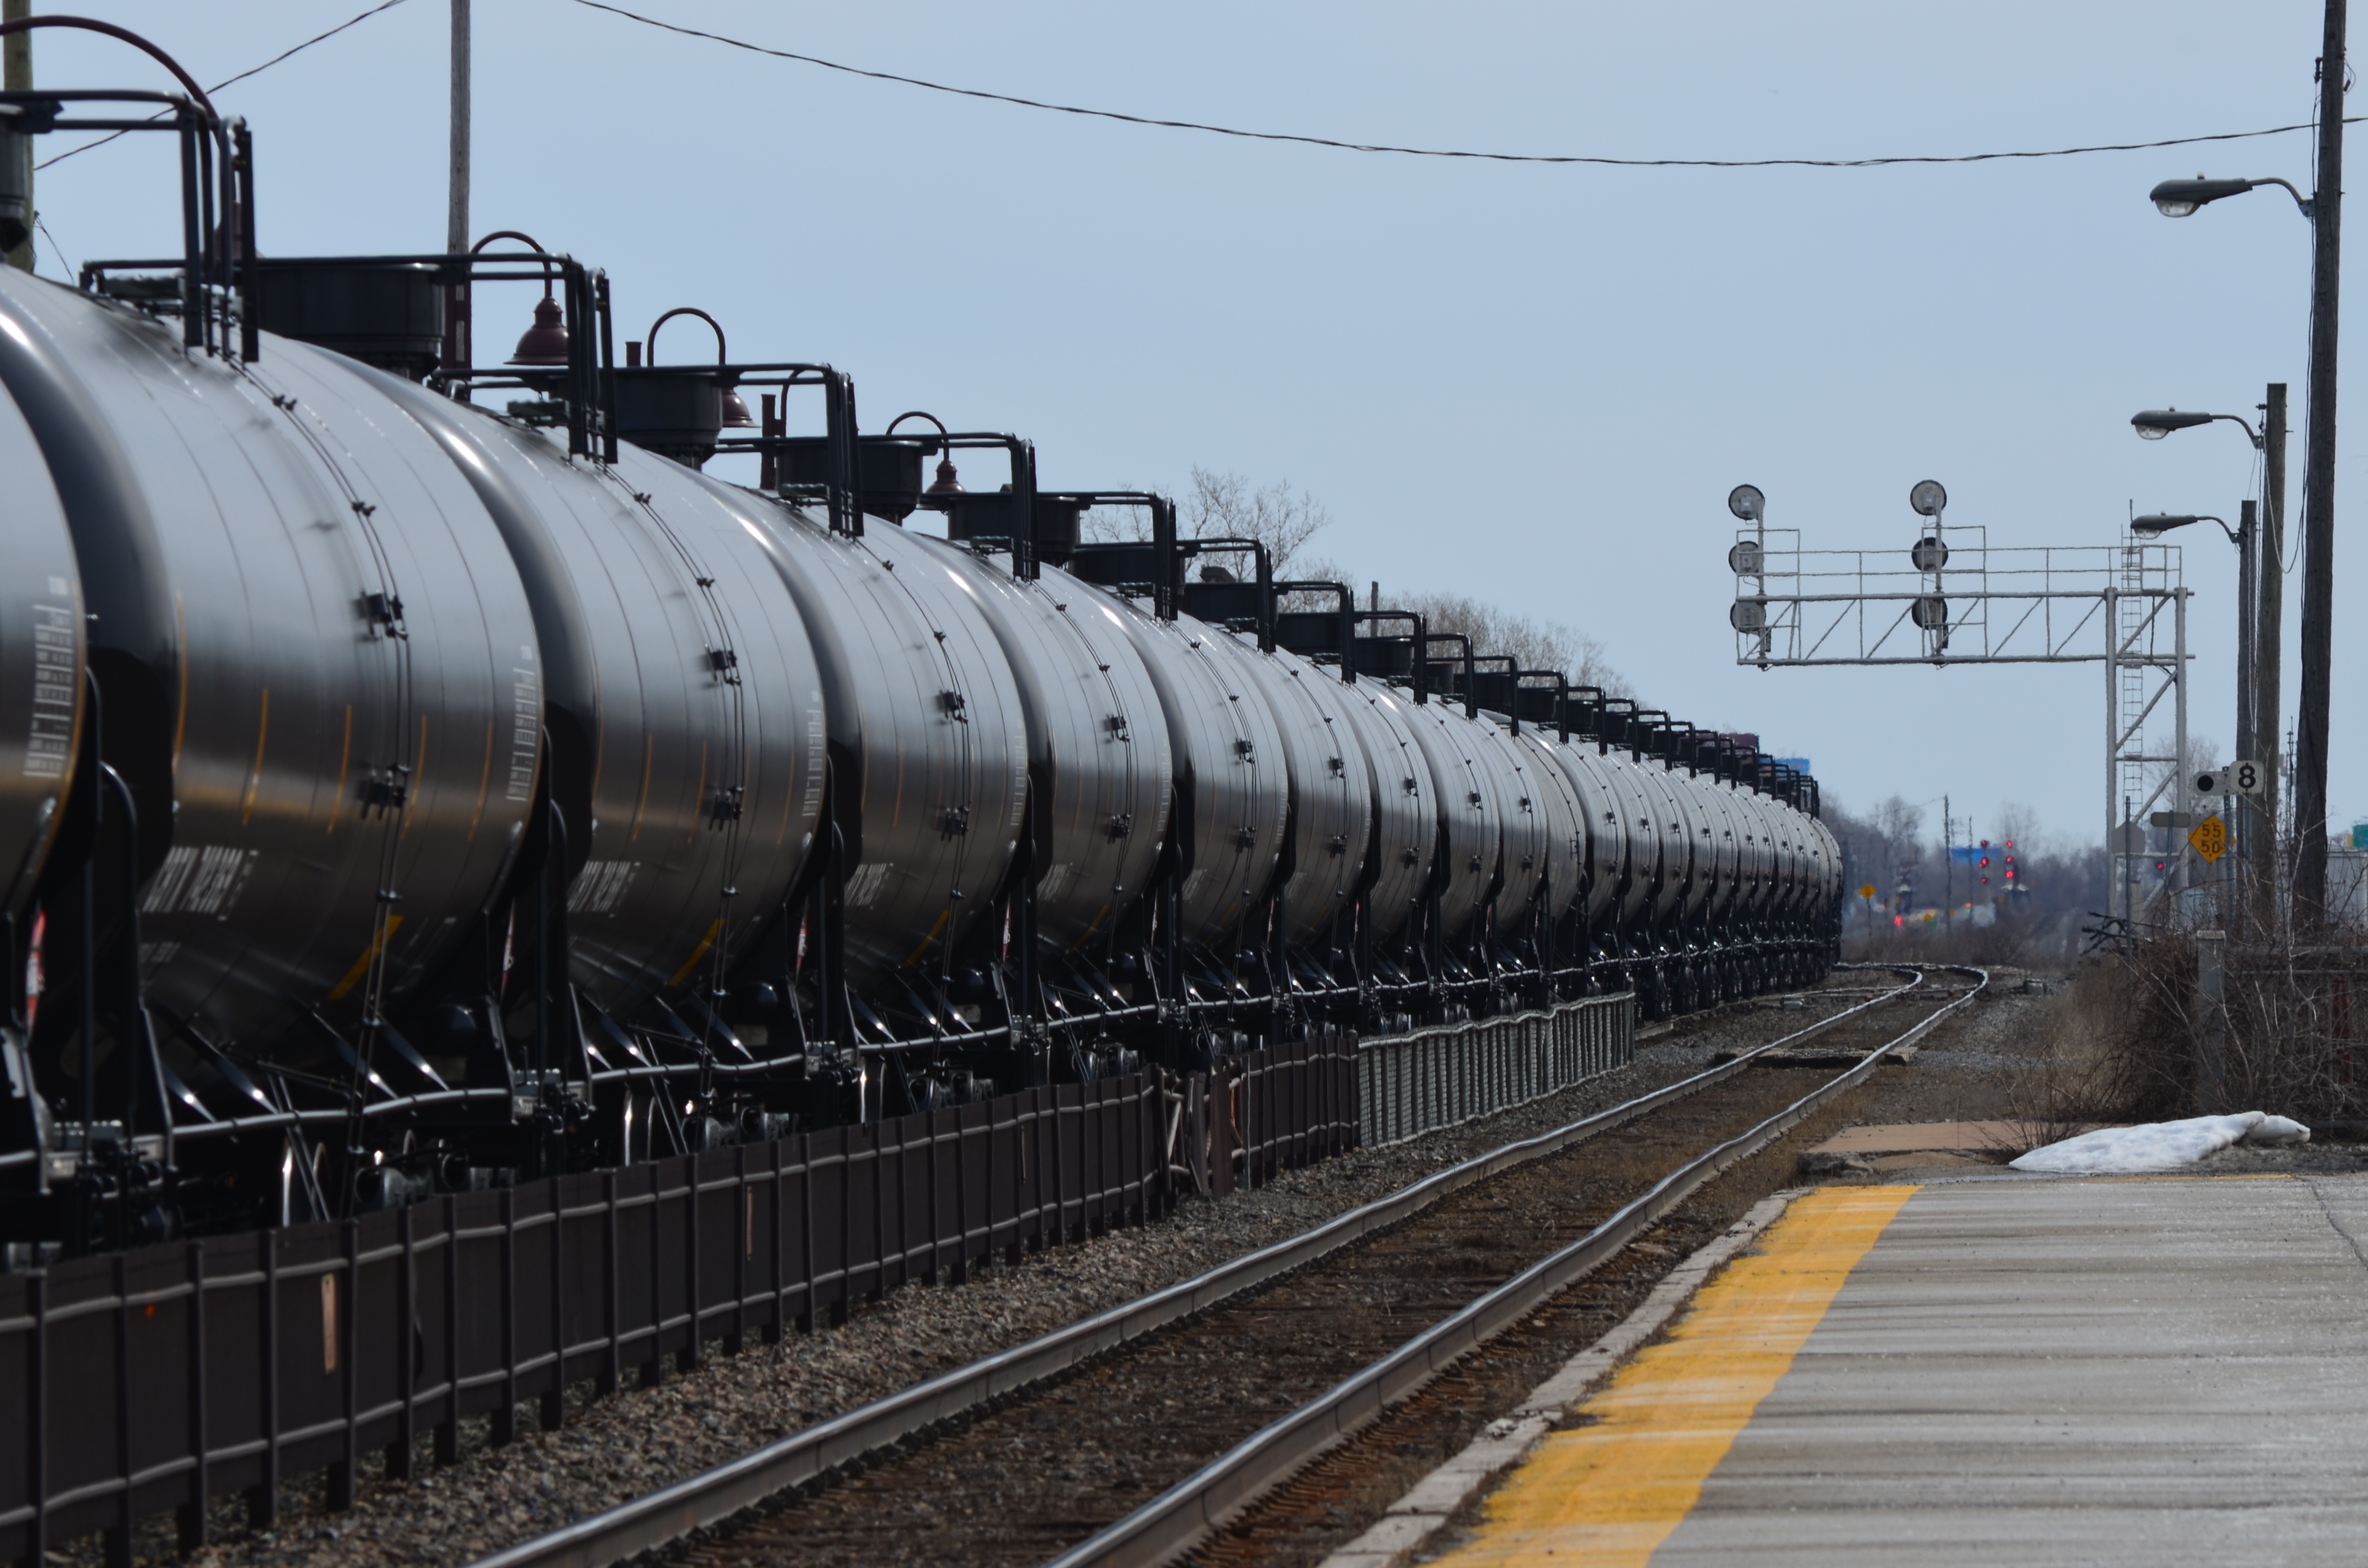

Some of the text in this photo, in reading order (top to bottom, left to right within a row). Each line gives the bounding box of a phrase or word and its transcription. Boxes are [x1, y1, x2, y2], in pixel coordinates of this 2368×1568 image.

[2238, 765, 2256, 789] 8
[2202, 824, 2221, 838] 55
[2201, 840, 2220, 854] 50
